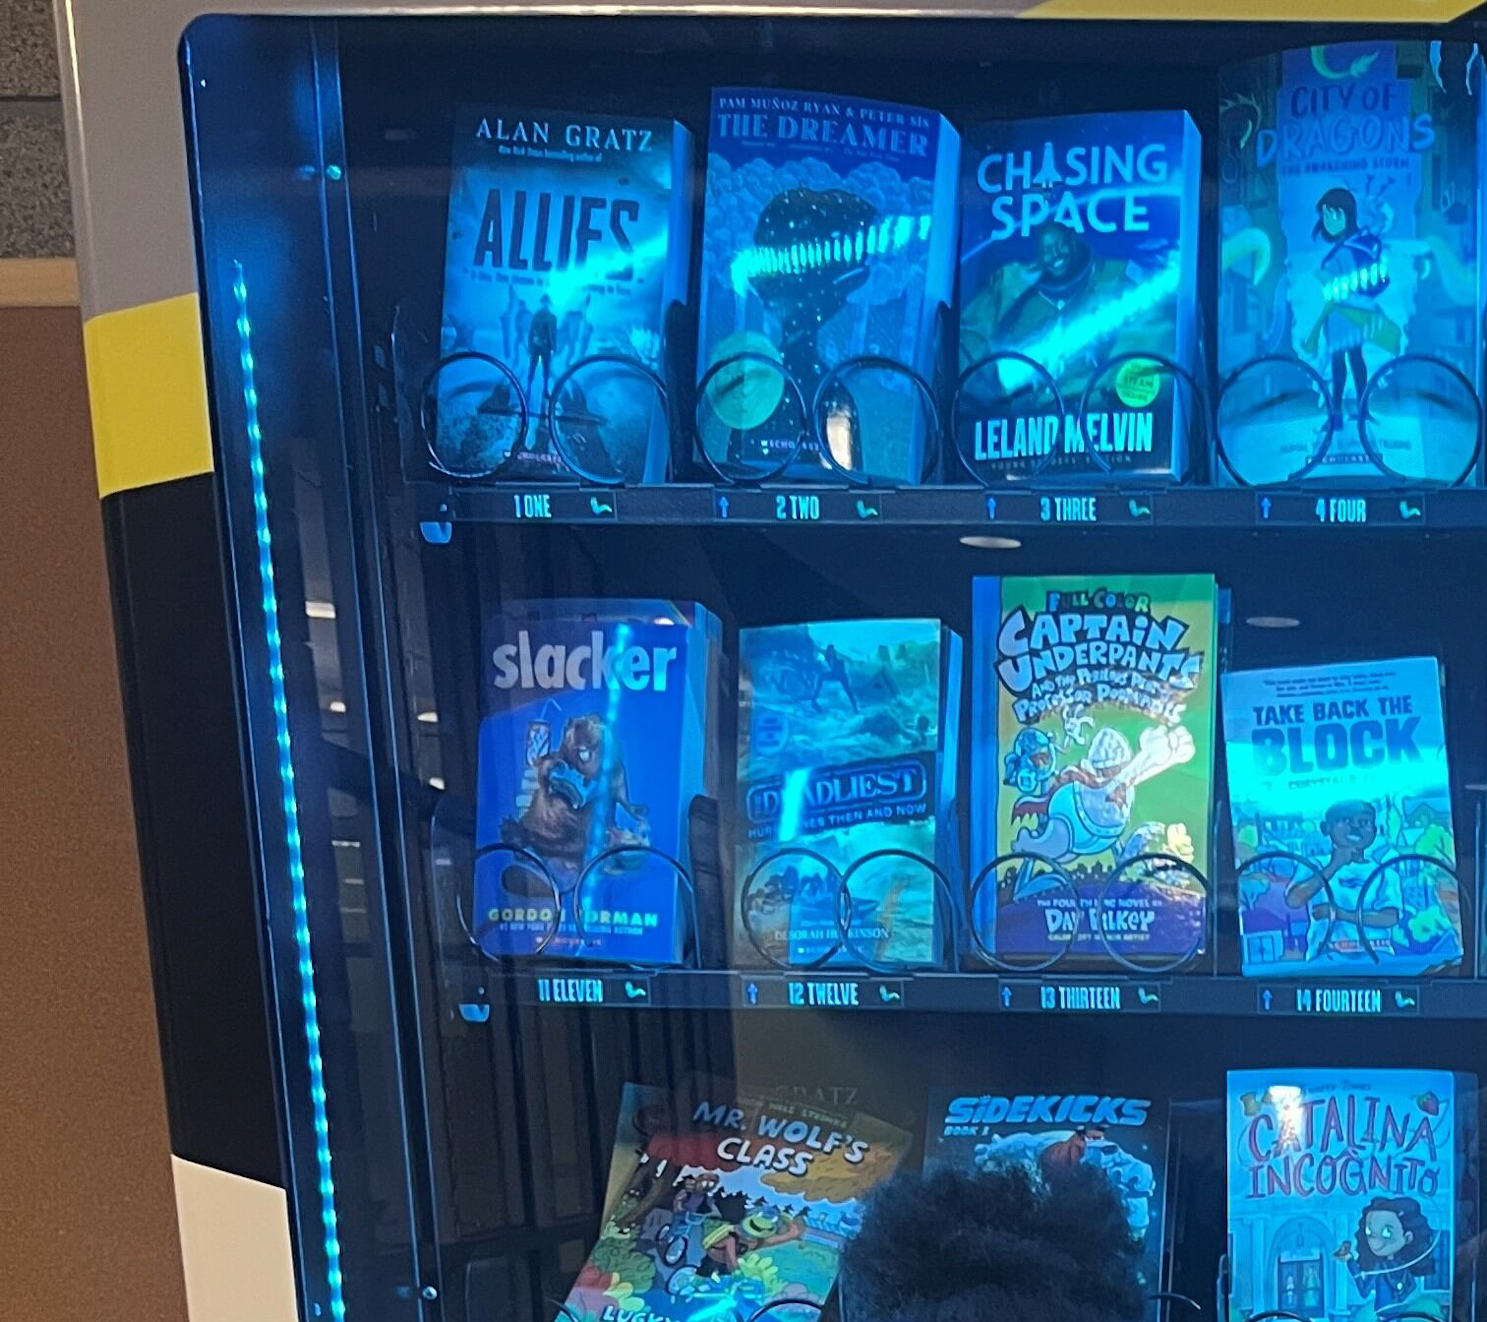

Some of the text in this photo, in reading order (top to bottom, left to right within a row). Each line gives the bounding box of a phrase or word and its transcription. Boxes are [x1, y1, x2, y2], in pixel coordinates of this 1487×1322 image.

[719, 97, 745, 109] PAM
[803, 102, 840, 116] RYAN
[1290, 83, 1356, 119] CITY
[475, 115, 653, 153] ALAN GRATZ
[718, 113, 768, 138] THE
[777, 115, 930, 158] DREAMER
[1256, 112, 1435, 167] DRAGONS
[977, 141, 1168, 191] CHASING
[472, 187, 641, 281] ALLIES
[991, 194, 1151, 241] SPACE
[974, 416, 1060, 461] LELAND
[520, 495, 551, 517] ONE
[775, 495, 820, 519] 2 TWO
[1040, 496, 1097, 520] 3 THREE
[1315, 498, 1367, 523] 4 FOUR
[1092, 587, 1151, 613] COLOR
[493, 629, 678, 693] slacker
[997, 640, 1203, 692] UNDERPANTS
[1252, 694, 1413, 726] TAKE BACK THE
[1251, 715, 1423, 777] BLOCK
[828, 802, 928, 825] THEN AND NOW
[537, 979, 604, 1003] 11 ELEVEN
[787, 982, 860, 1007] 12 TWELVE
[1040, 986, 1121, 1010] 13 THIRTEEN
[1295, 989, 1382, 1013] 14 FOURTEEN
[692, 1100, 870, 1164] MR. WOLF'S
[944, 1126, 979, 1136] BOOK
[1248, 1093, 1438, 1163] CATALINA
[716, 1136, 814, 1176] CLASS
[1245, 1149, 1441, 1200] INCOGNITO
